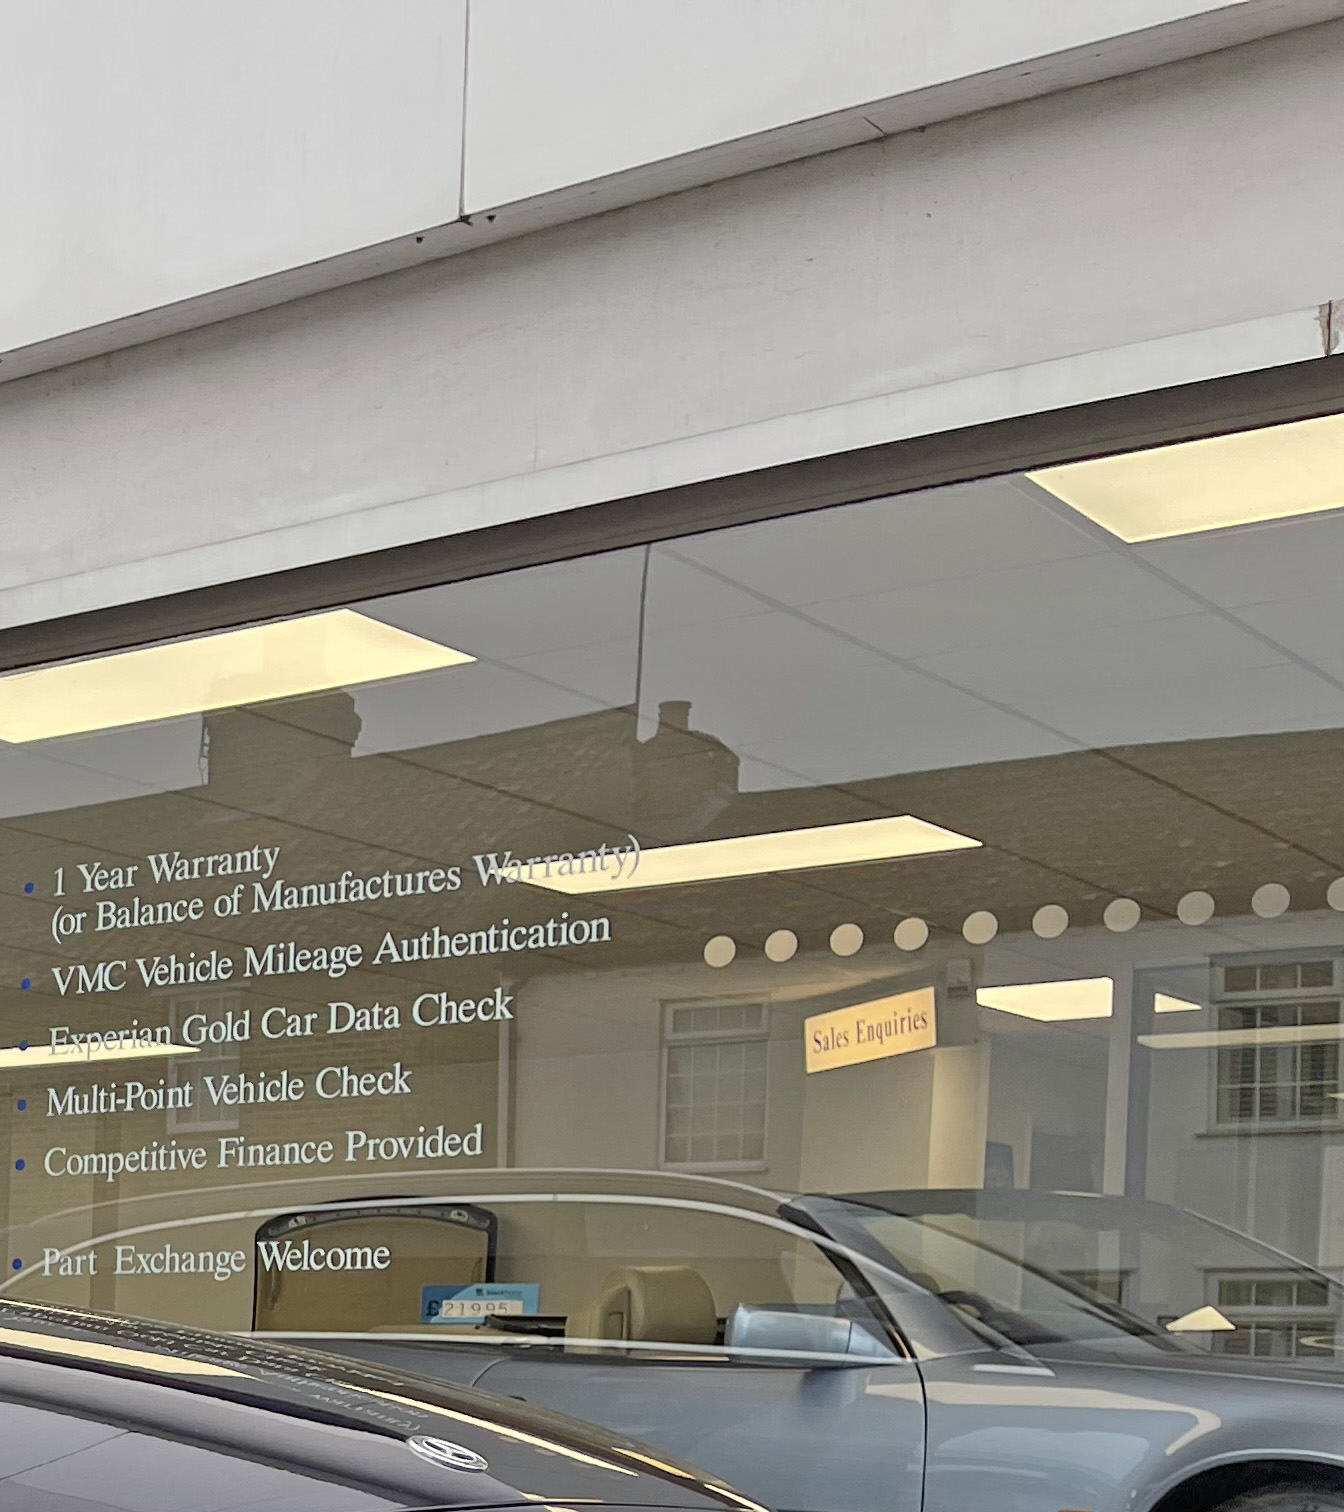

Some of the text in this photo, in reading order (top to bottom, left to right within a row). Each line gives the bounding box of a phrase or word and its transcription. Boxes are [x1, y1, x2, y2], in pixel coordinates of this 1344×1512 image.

[51, 834, 641, 944] (or Balance of Manufactures Warranty)
[52, 843, 280, 897] 1 Year Warranty
[51, 913, 612, 996] VMC Vehicle Mileage Authentication
[48, 986, 514, 1063] Experian Gold Car Data Check
[813, 1008, 928, 1054] Sales Enquiries
[46, 1061, 412, 1118] Multi-Point Vehicle Check
[43, 1123, 483, 1182] Competitive Finance Provided
[42, 1239, 391, 1282] Part Exchange Welcome
